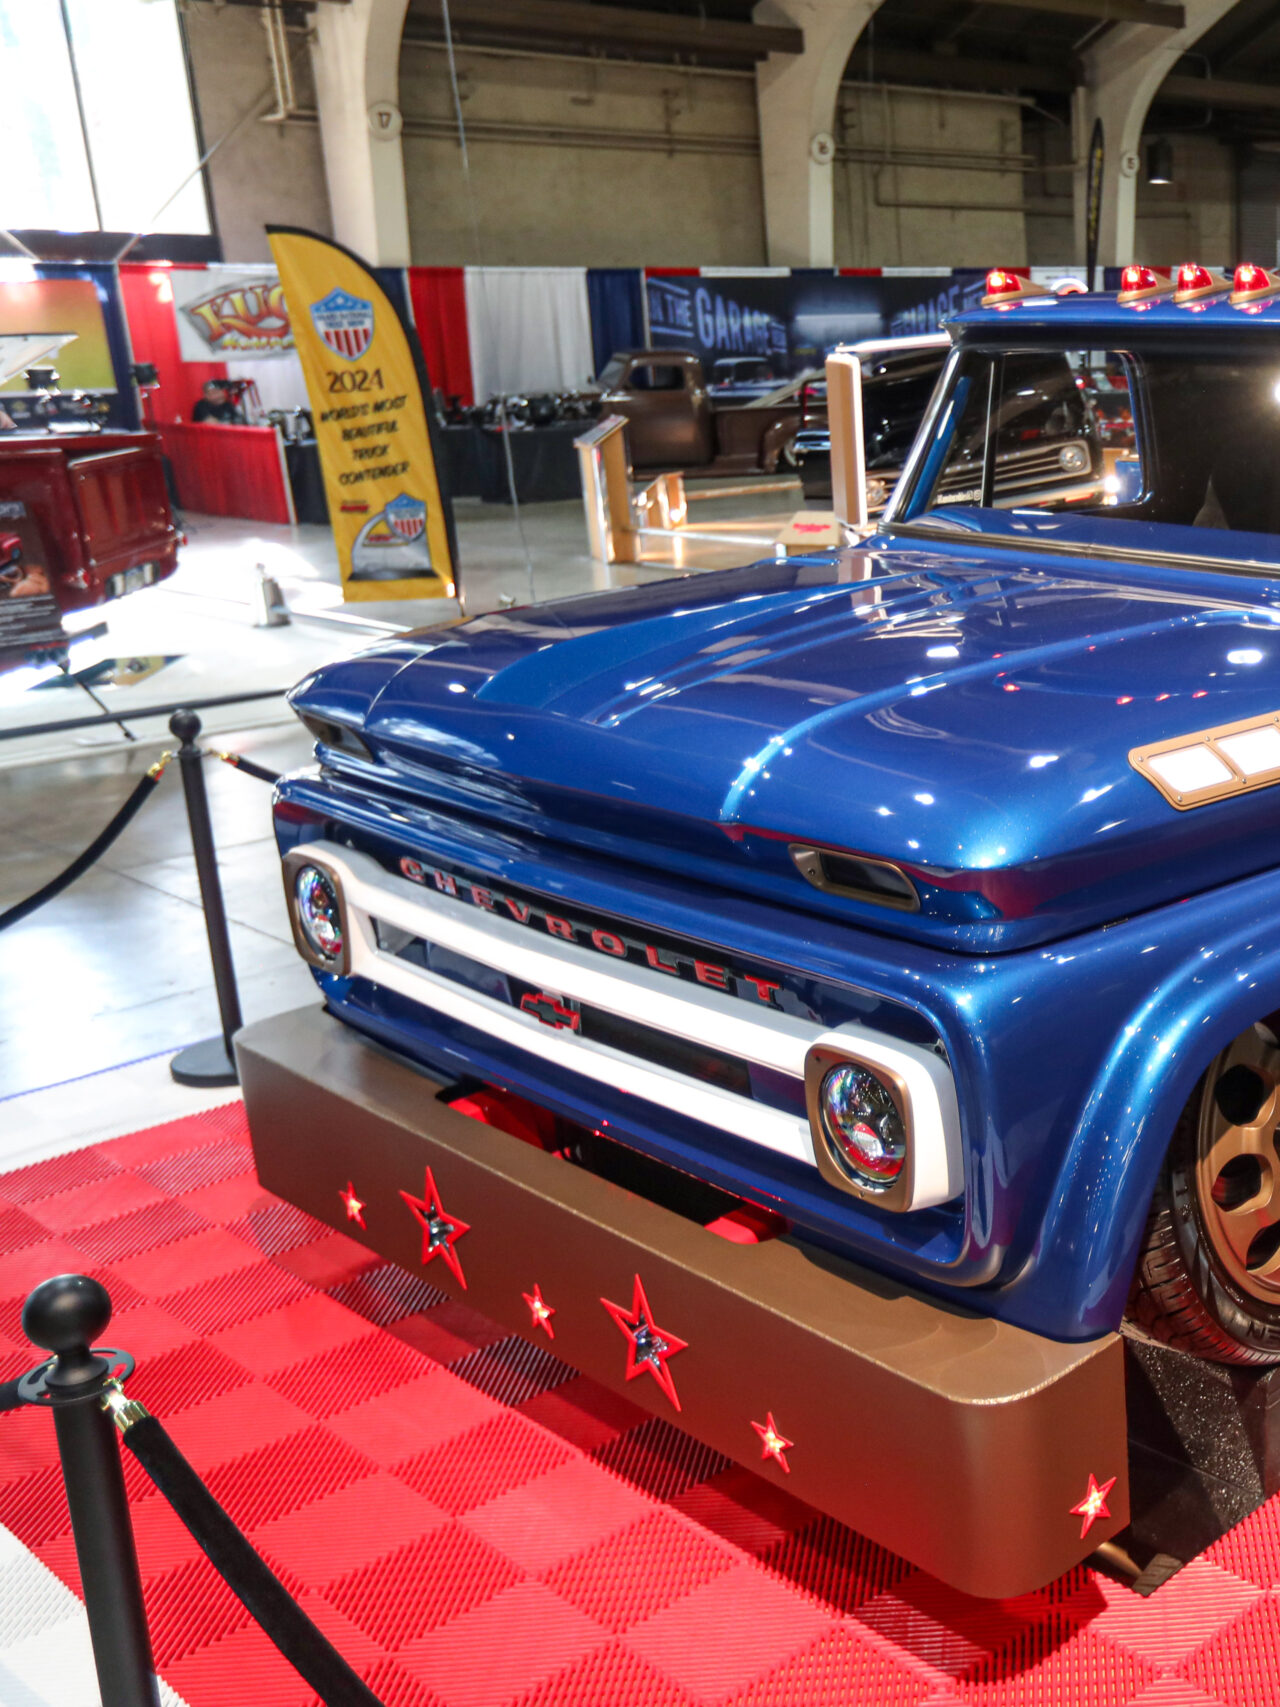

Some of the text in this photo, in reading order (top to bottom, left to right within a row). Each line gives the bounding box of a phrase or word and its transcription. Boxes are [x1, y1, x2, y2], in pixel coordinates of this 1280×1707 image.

[694, 287, 770, 355] GARAGE
[326, 368, 385, 393] 2024
[353, 444, 390, 460] TRUCK
[338, 461, 410, 486] CONTENDER
[400, 856, 783, 1005] CHEVROLET
